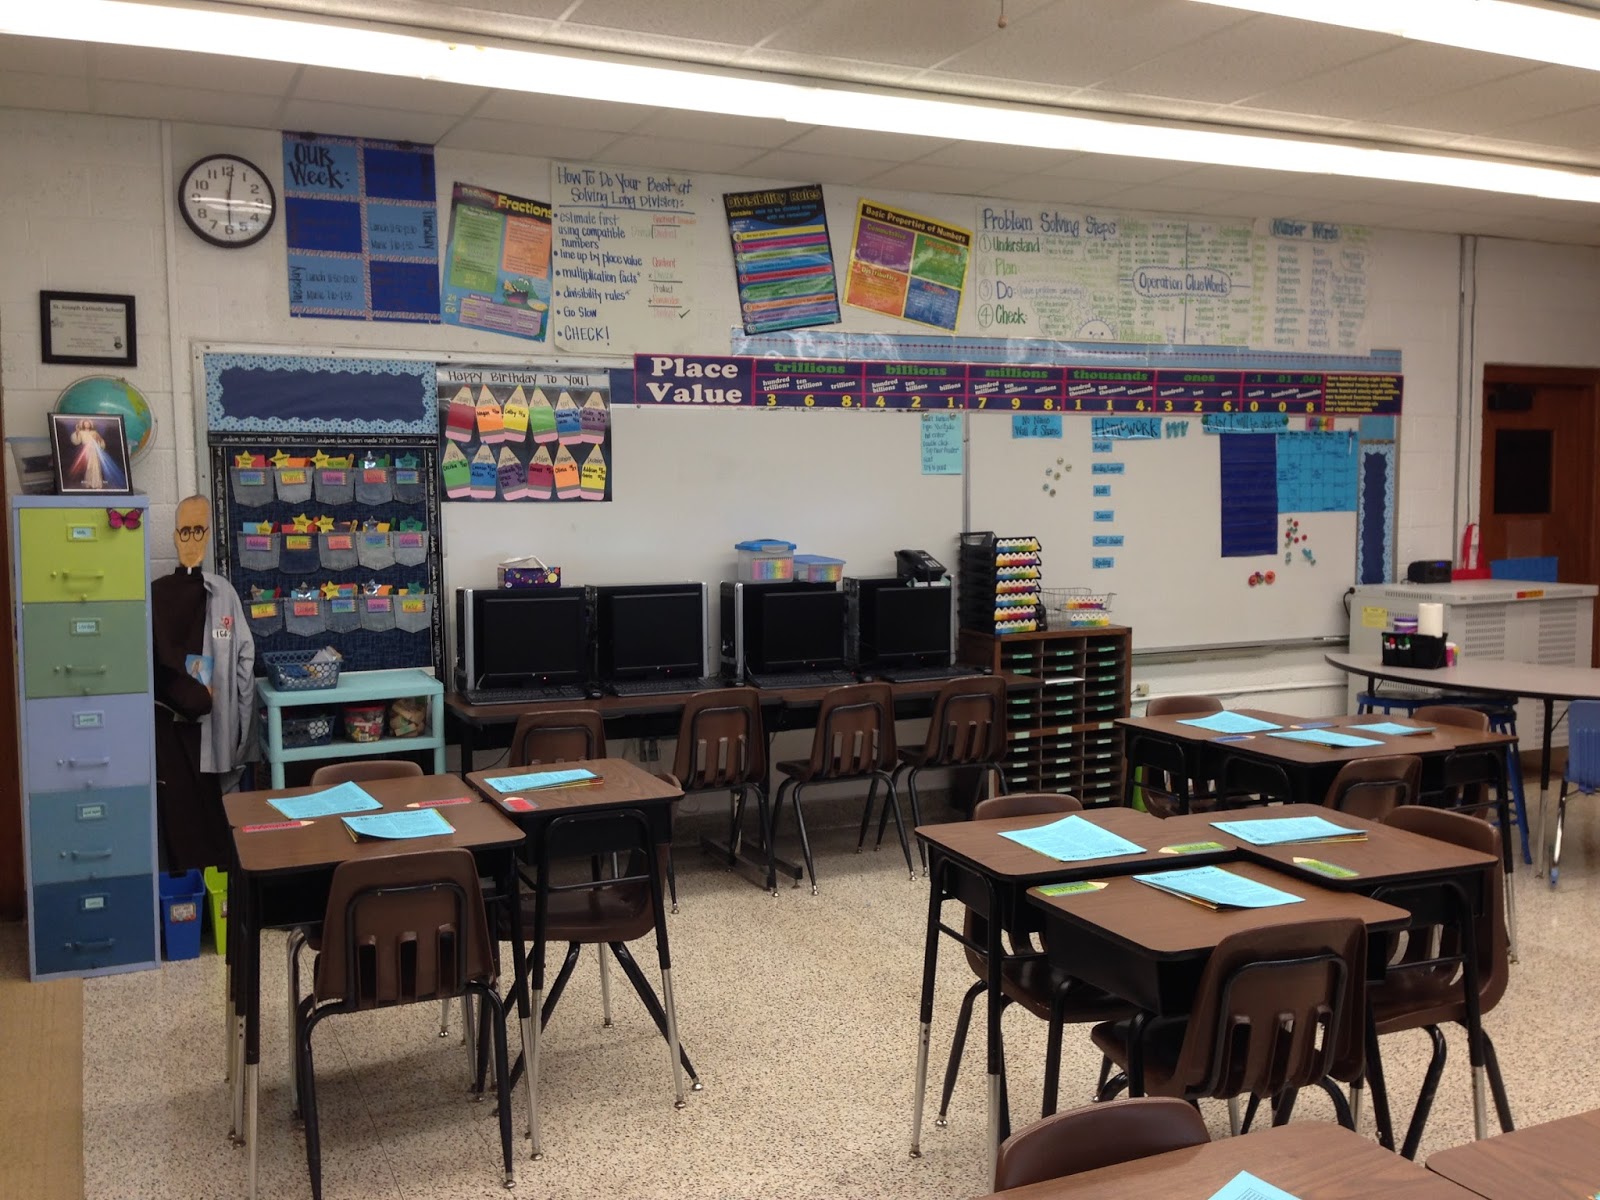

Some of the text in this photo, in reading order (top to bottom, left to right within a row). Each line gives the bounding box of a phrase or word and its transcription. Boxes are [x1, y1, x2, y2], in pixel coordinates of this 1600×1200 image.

[208, 169, 217, 179] 11
[558, 166, 580, 186] How
[582, 169, 596, 186] To
[599, 170, 613, 187] Do
[615, 173, 642, 193] Your
[677, 179, 693, 194] at
[195, 180, 209, 190] 10
[250, 184, 259, 194] 2
[571, 187, 608, 208] Solving
[611, 191, 635, 209] Long
[498, 194, 552, 219] Fractions
[197, 208, 207, 219] 8
[249, 213, 259, 222] 4
[559, 211, 619, 226] estimate first
[209, 219, 218, 229] 7
[225, 224, 234, 235] 6
[239, 221, 248, 232] 5
[865, 206, 966, 242] Basic Properties of Numbers
[983, 207, 1117, 242] Problem Solving Steps
[558, 226, 626, 242] using compatible
[561, 237, 600, 250] numbers
[560, 249, 643, 267] line up by place value
[562, 265, 617, 285] multiplication
[1139, 272, 1228, 294] Operation Clue Words
[563, 288, 602, 304] divisibility
[563, 306, 597, 318] Go Slow
[564, 324, 610, 346] CHECK!
[651, 357, 739, 378] Place
[774, 362, 846, 374] trillions
[885, 364, 947, 376] billions
[985, 368, 1049, 379] millions
[448, 370, 589, 386] Happy Birthday To You!
[762, 376, 790, 386] hundred
[1073, 369, 1148, 381] thousands
[1184, 374, 1216, 382] ones
[764, 382, 790, 391] trillions
[797, 381, 823, 390] trillions
[830, 381, 855, 390] trillions
[872, 379, 898, 388] hundred
[872, 385, 896, 393] billions
[905, 383, 928, 392] billions
[939, 383, 961, 391] billions
[974, 381, 999, 390] hundred
[646, 382, 742, 404] Value
[766, 393, 777, 407] 3
[804, 394, 815, 407] 6
[875, 395, 886, 408] 4
[911, 395, 921, 408] 2
[978, 397, 987, 410] 7
[1011, 397, 1021, 410] 9
[1075, 399, 1082, 410] 1
[1106, 399, 1113, 411] 1
[1164, 400, 1173, 412] 3
[1193, 401, 1203, 412] 2
[1250, 401, 1259, 412] 0
[1278, 401, 1287, 412] 0
[1306, 402, 1314, 413] 8
